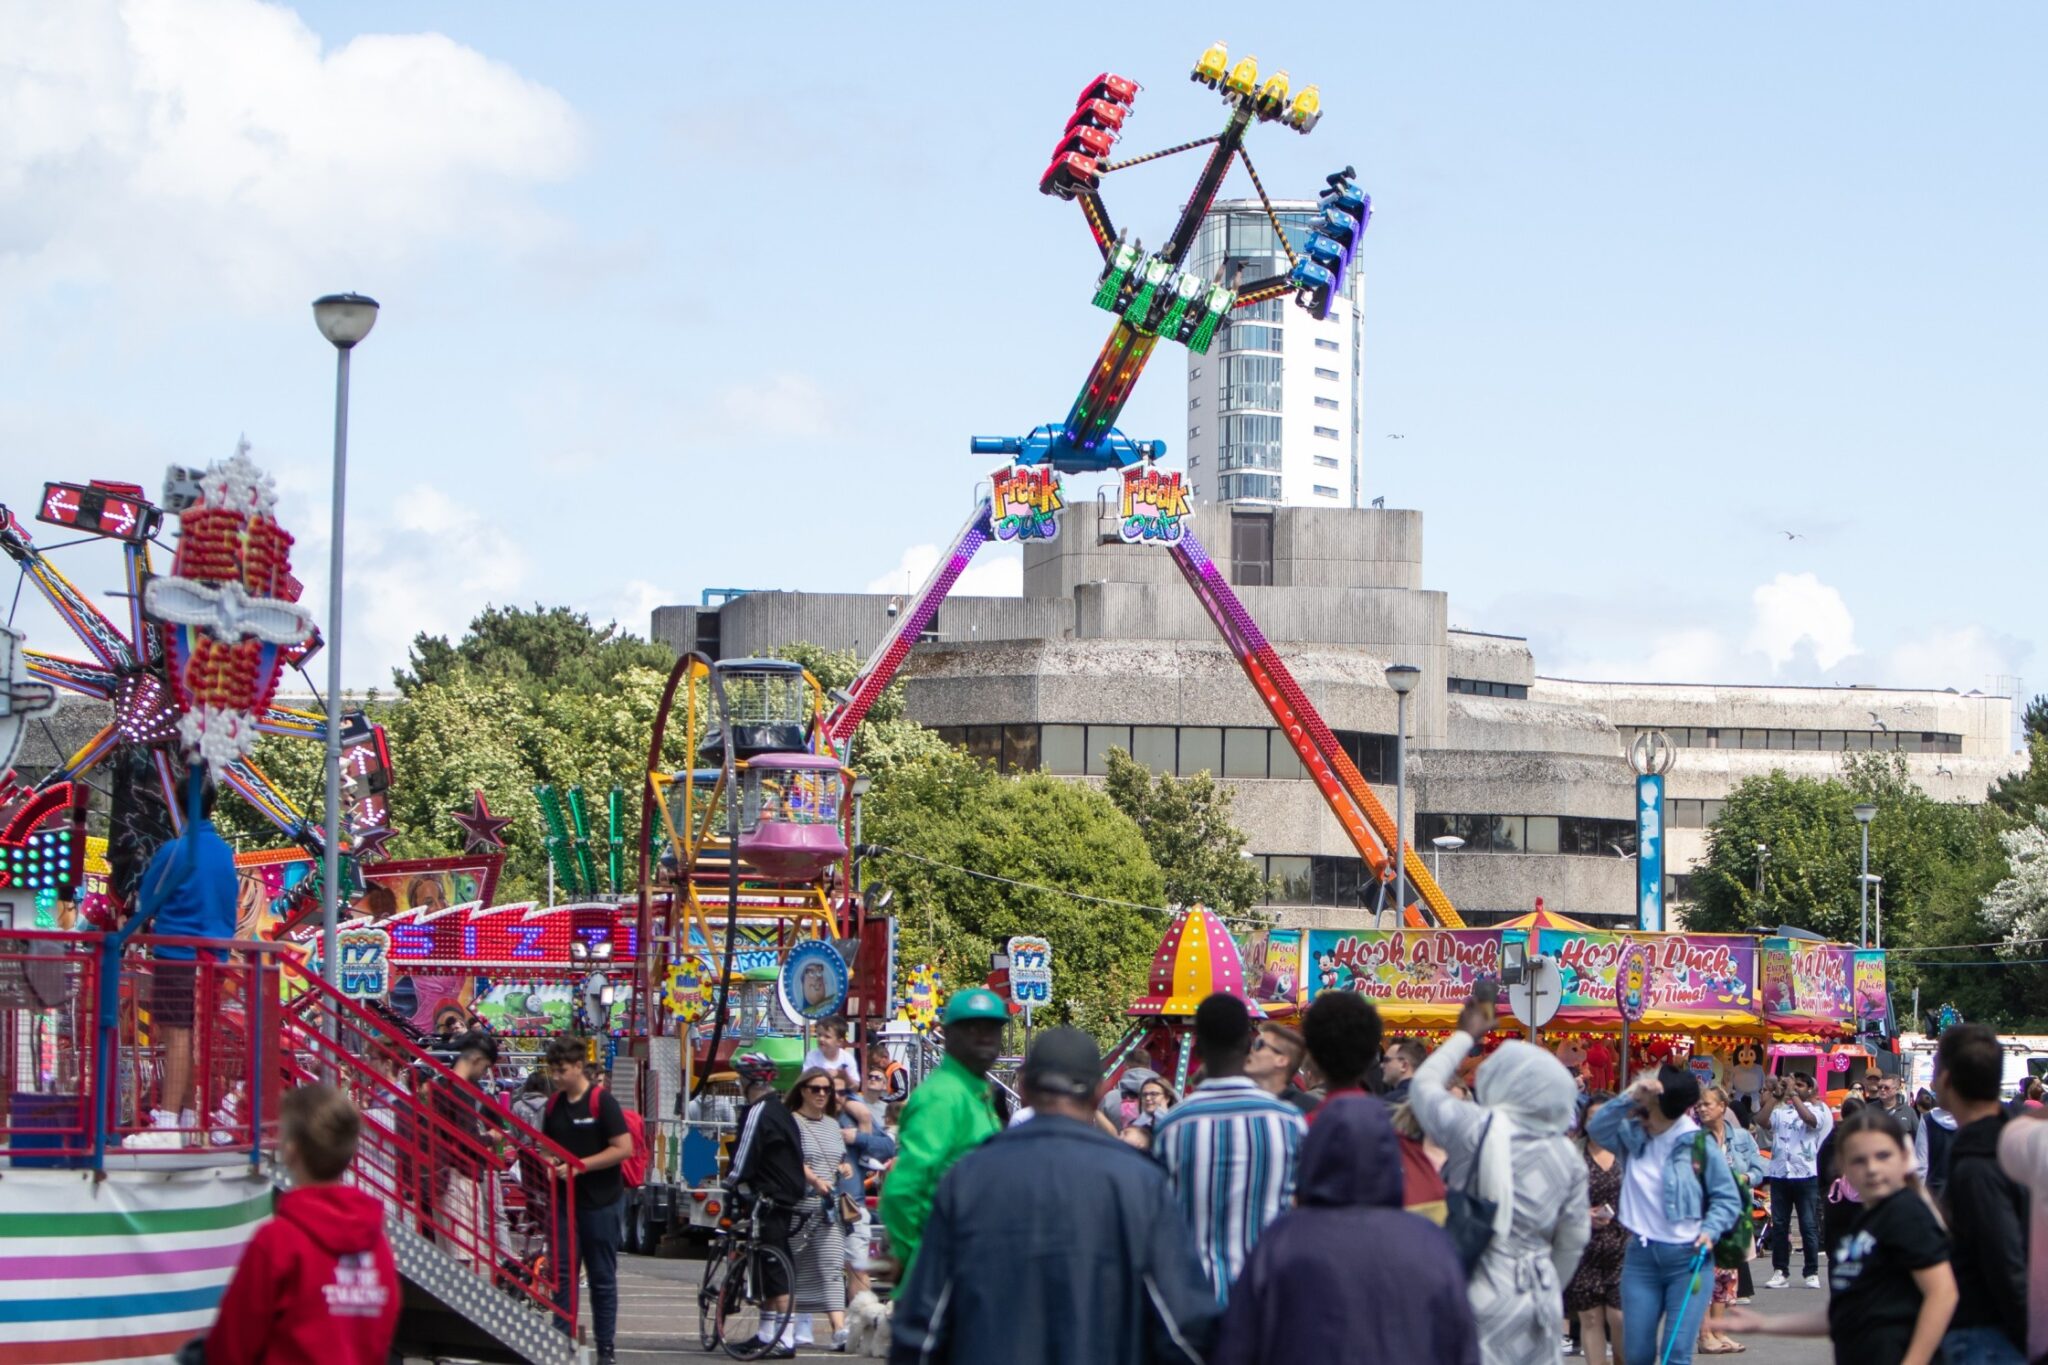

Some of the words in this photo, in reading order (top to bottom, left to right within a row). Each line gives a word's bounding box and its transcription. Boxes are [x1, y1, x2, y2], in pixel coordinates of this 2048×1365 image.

[1333, 931, 1406, 972] Hook
[1435, 931, 1498, 973] Duck
[1662, 936, 1731, 979] Duck
[1353, 978, 1393, 999] Prize
[1395, 979, 1437, 1004] Every
[1578, 981, 1616, 1001] Prize
[1664, 983, 1707, 1003] Time!
